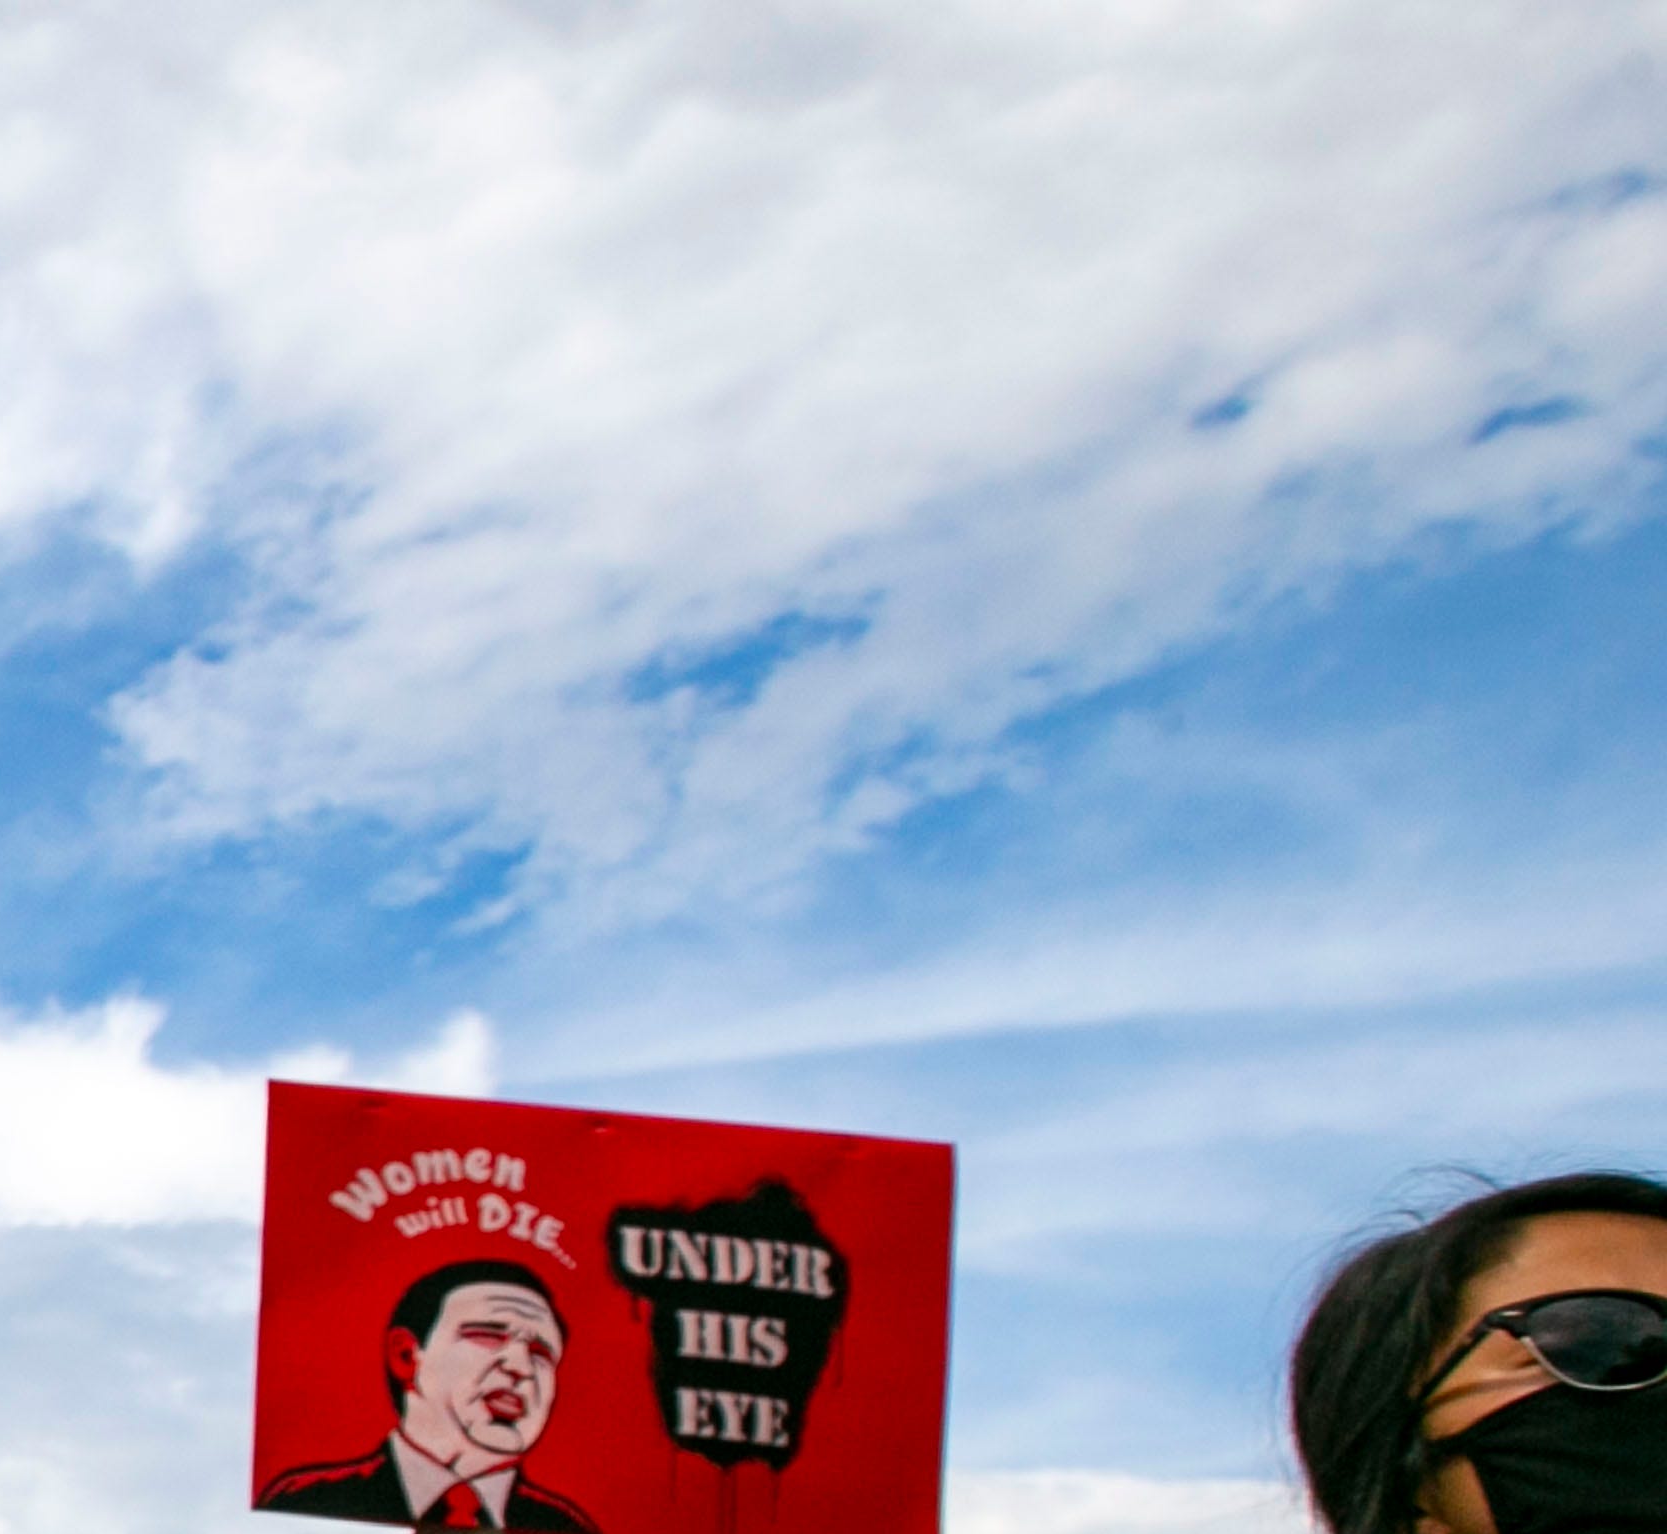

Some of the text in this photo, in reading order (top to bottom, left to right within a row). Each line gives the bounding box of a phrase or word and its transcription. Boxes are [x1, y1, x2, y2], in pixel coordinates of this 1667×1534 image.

[328, 1146, 527, 1223] Women
[393, 1196, 469, 1239] will
[619, 1224, 836, 1299] UNDER
[676, 1308, 790, 1369] HIS
[676, 1388, 791, 1449] EYE
